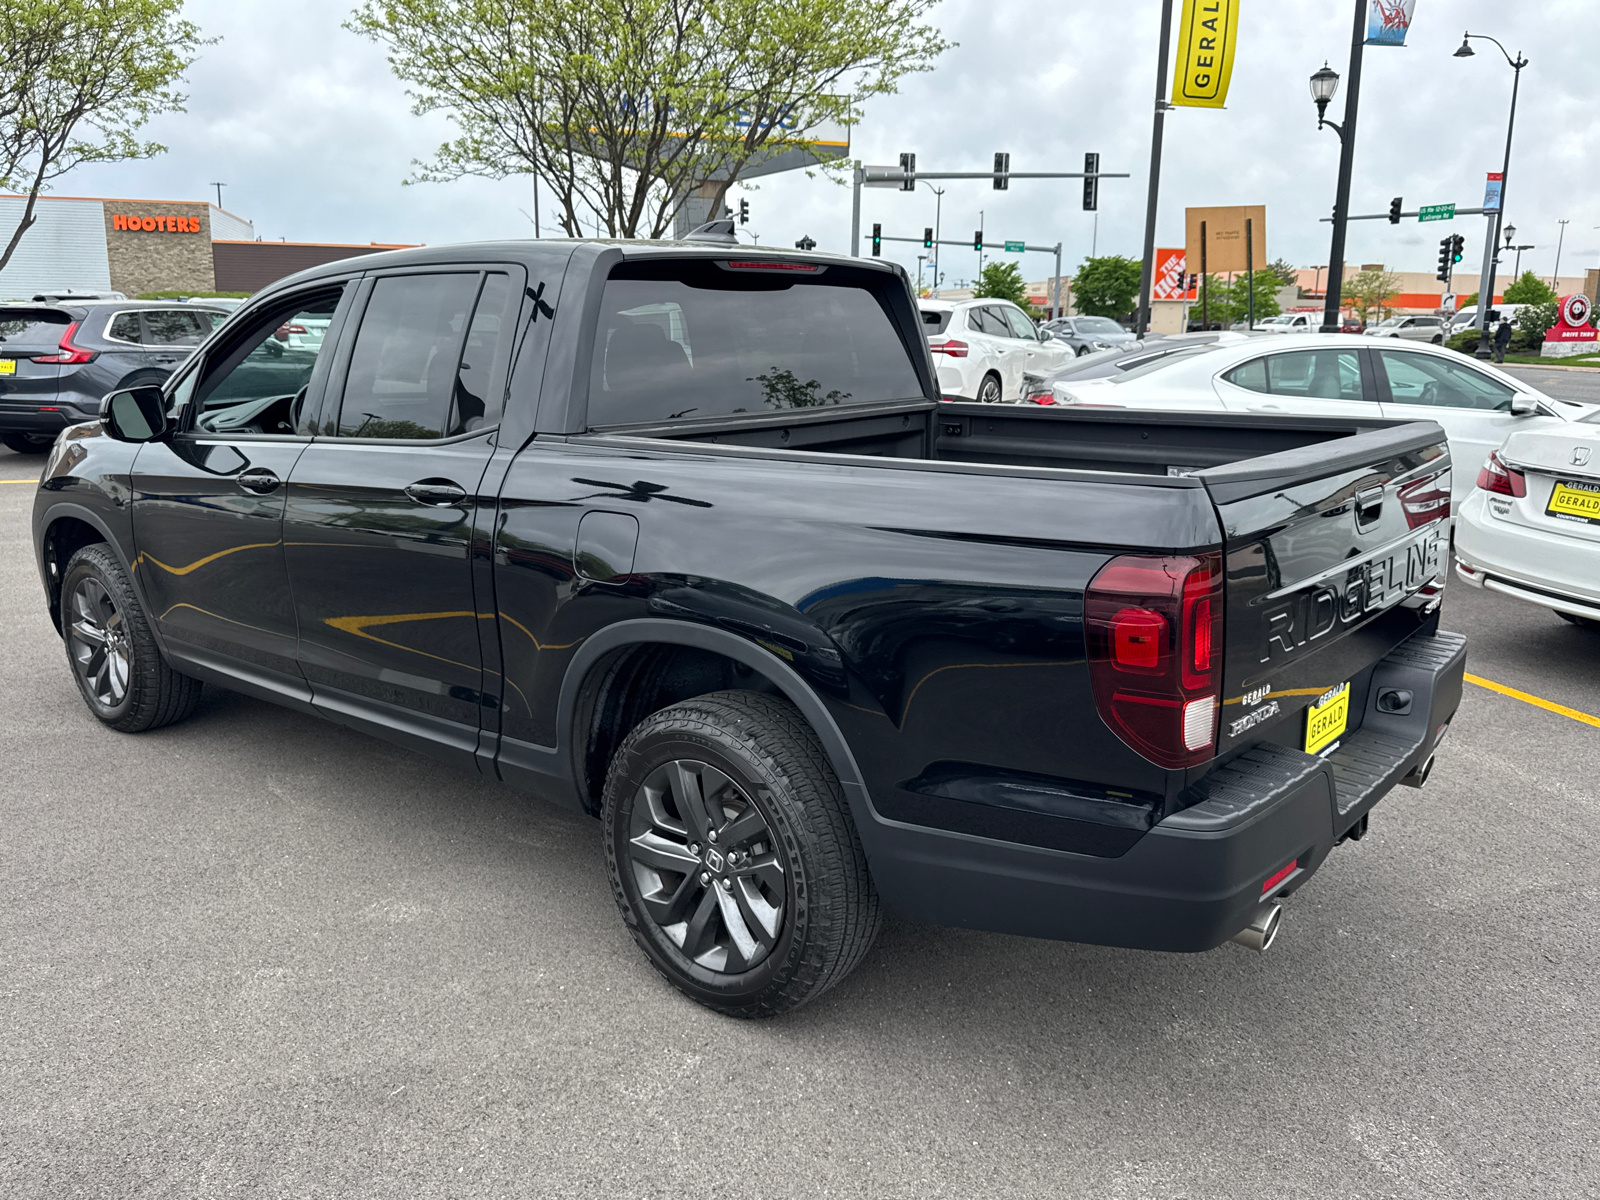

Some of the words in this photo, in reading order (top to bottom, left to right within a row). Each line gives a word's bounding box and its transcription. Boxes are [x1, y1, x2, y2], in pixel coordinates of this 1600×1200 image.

[1194, 1, 1219, 88] GERAL
[113, 214, 200, 233] HOOTERS
[1159, 254, 1180, 275] THE
[1567, 482, 1599, 493] GERALD
[1559, 495, 1599, 510] GERALD
[1260, 530, 1440, 662] RIDGELINE
[1242, 684, 1271, 706] GERALD
[1318, 682, 1345, 707] GERALD
[1228, 701, 1280, 737] HONDA
[1311, 705, 1343, 739] GERALD
